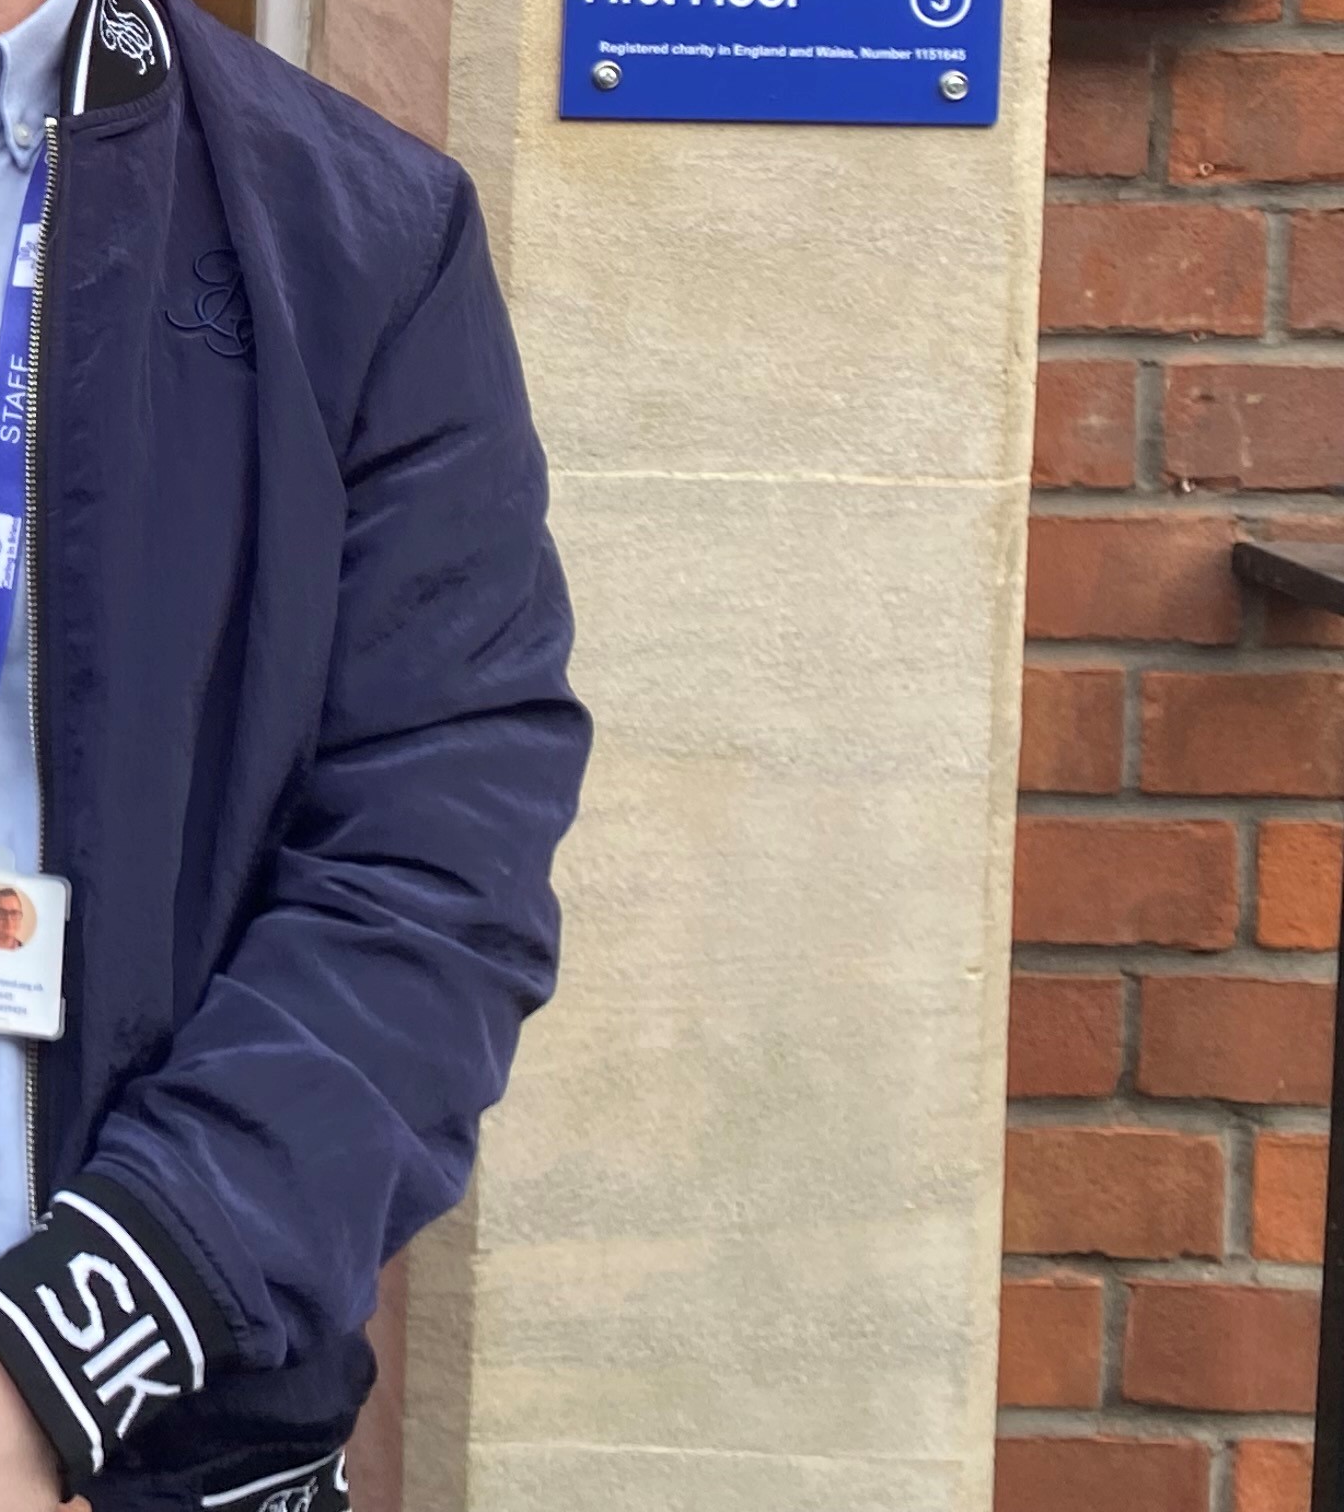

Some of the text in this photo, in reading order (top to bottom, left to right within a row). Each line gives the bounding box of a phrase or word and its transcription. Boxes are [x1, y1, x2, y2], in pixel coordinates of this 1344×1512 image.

[599, 40, 669, 56] Registered
[671, 42, 714, 58] charity
[717, 43, 732, 57] in
[733, 43, 787, 59] England
[788, 45, 814, 58] and
[859, 45, 912, 60] Number
